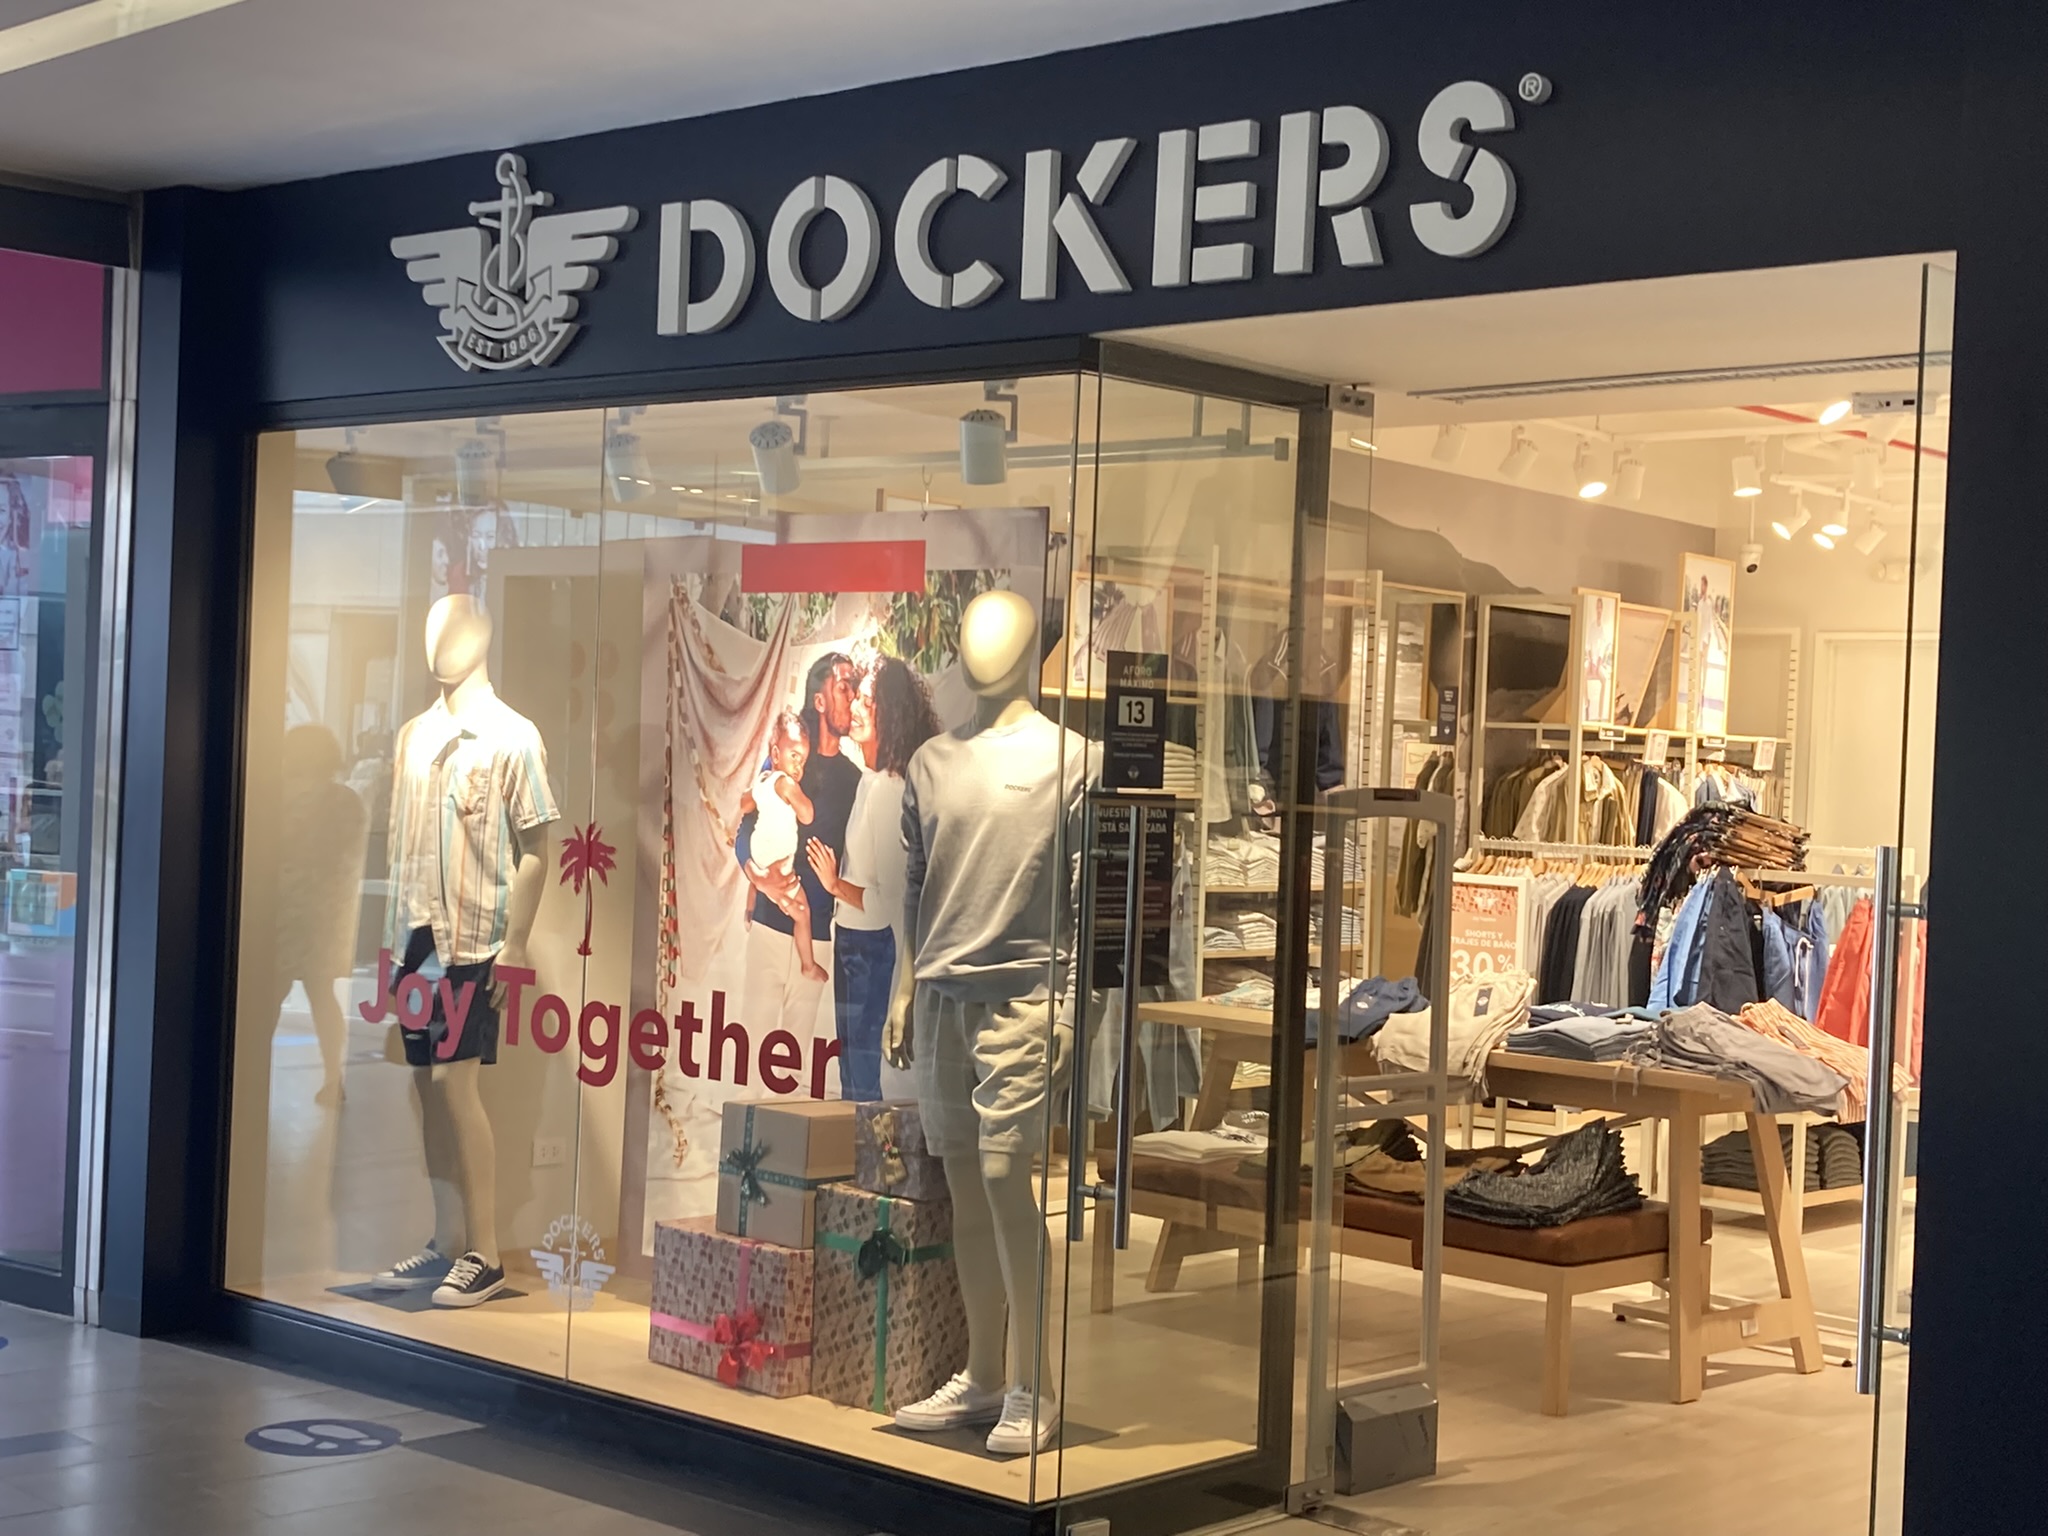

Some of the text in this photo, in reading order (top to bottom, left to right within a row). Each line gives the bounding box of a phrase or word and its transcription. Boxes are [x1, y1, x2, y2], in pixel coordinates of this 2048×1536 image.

[656, 80, 1517, 336] DOCKERS
[467, 327, 537, 359] EST 1986
[1123, 665, 1153, 677] AFORO
[1126, 700, 1145, 724] 13
[1098, 807, 1131, 818] NUESTR
[1451, 936, 1516, 949] TRAJES DE BAÑO
[1465, 929, 1503, 939] SHORTS Y
[358, 947, 842, 1099] Joy Together
[542, 1214, 606, 1261] DOCKERS
